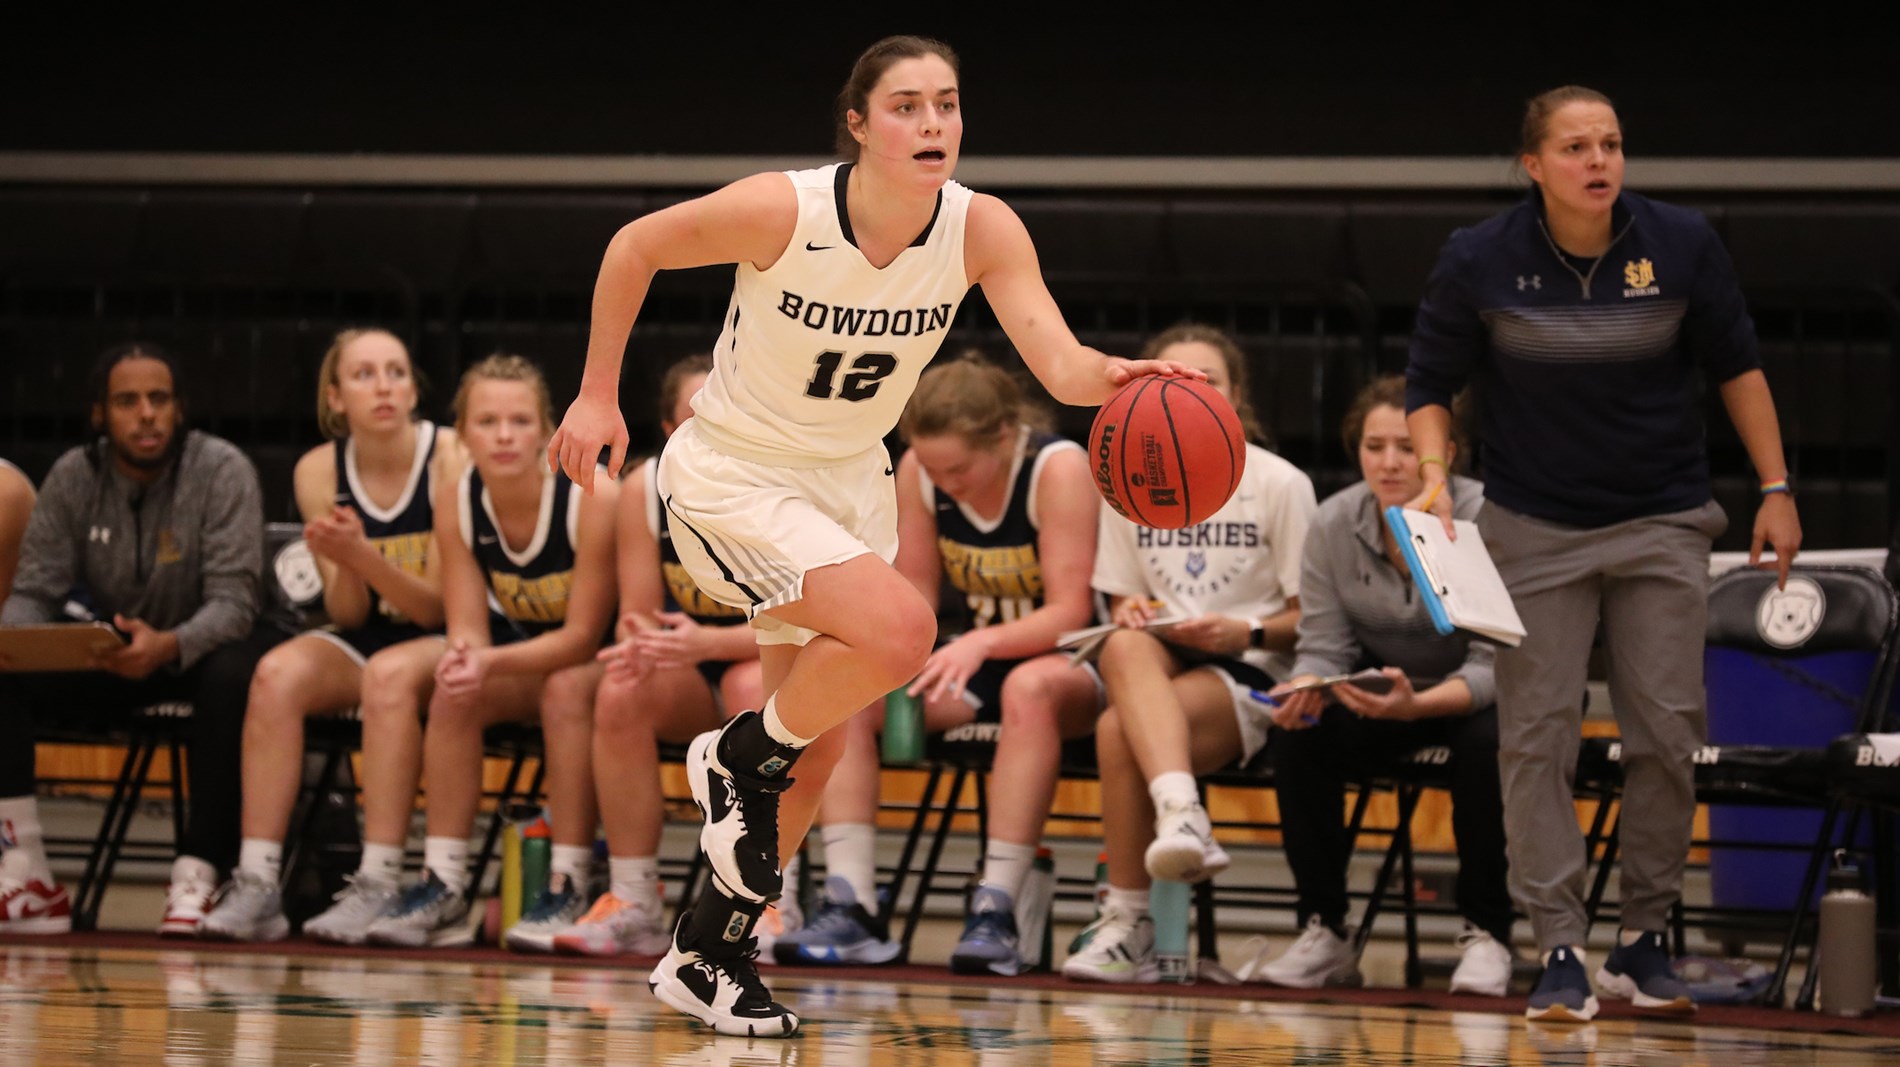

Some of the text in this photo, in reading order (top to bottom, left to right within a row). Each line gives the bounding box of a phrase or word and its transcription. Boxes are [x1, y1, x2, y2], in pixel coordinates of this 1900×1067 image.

[777, 290, 952, 337] BOWDOIN
[803, 348, 900, 403] 12
[1145, 433, 1161, 487] BASKETBALL
[1137, 522, 1259, 548] HUSKIES
